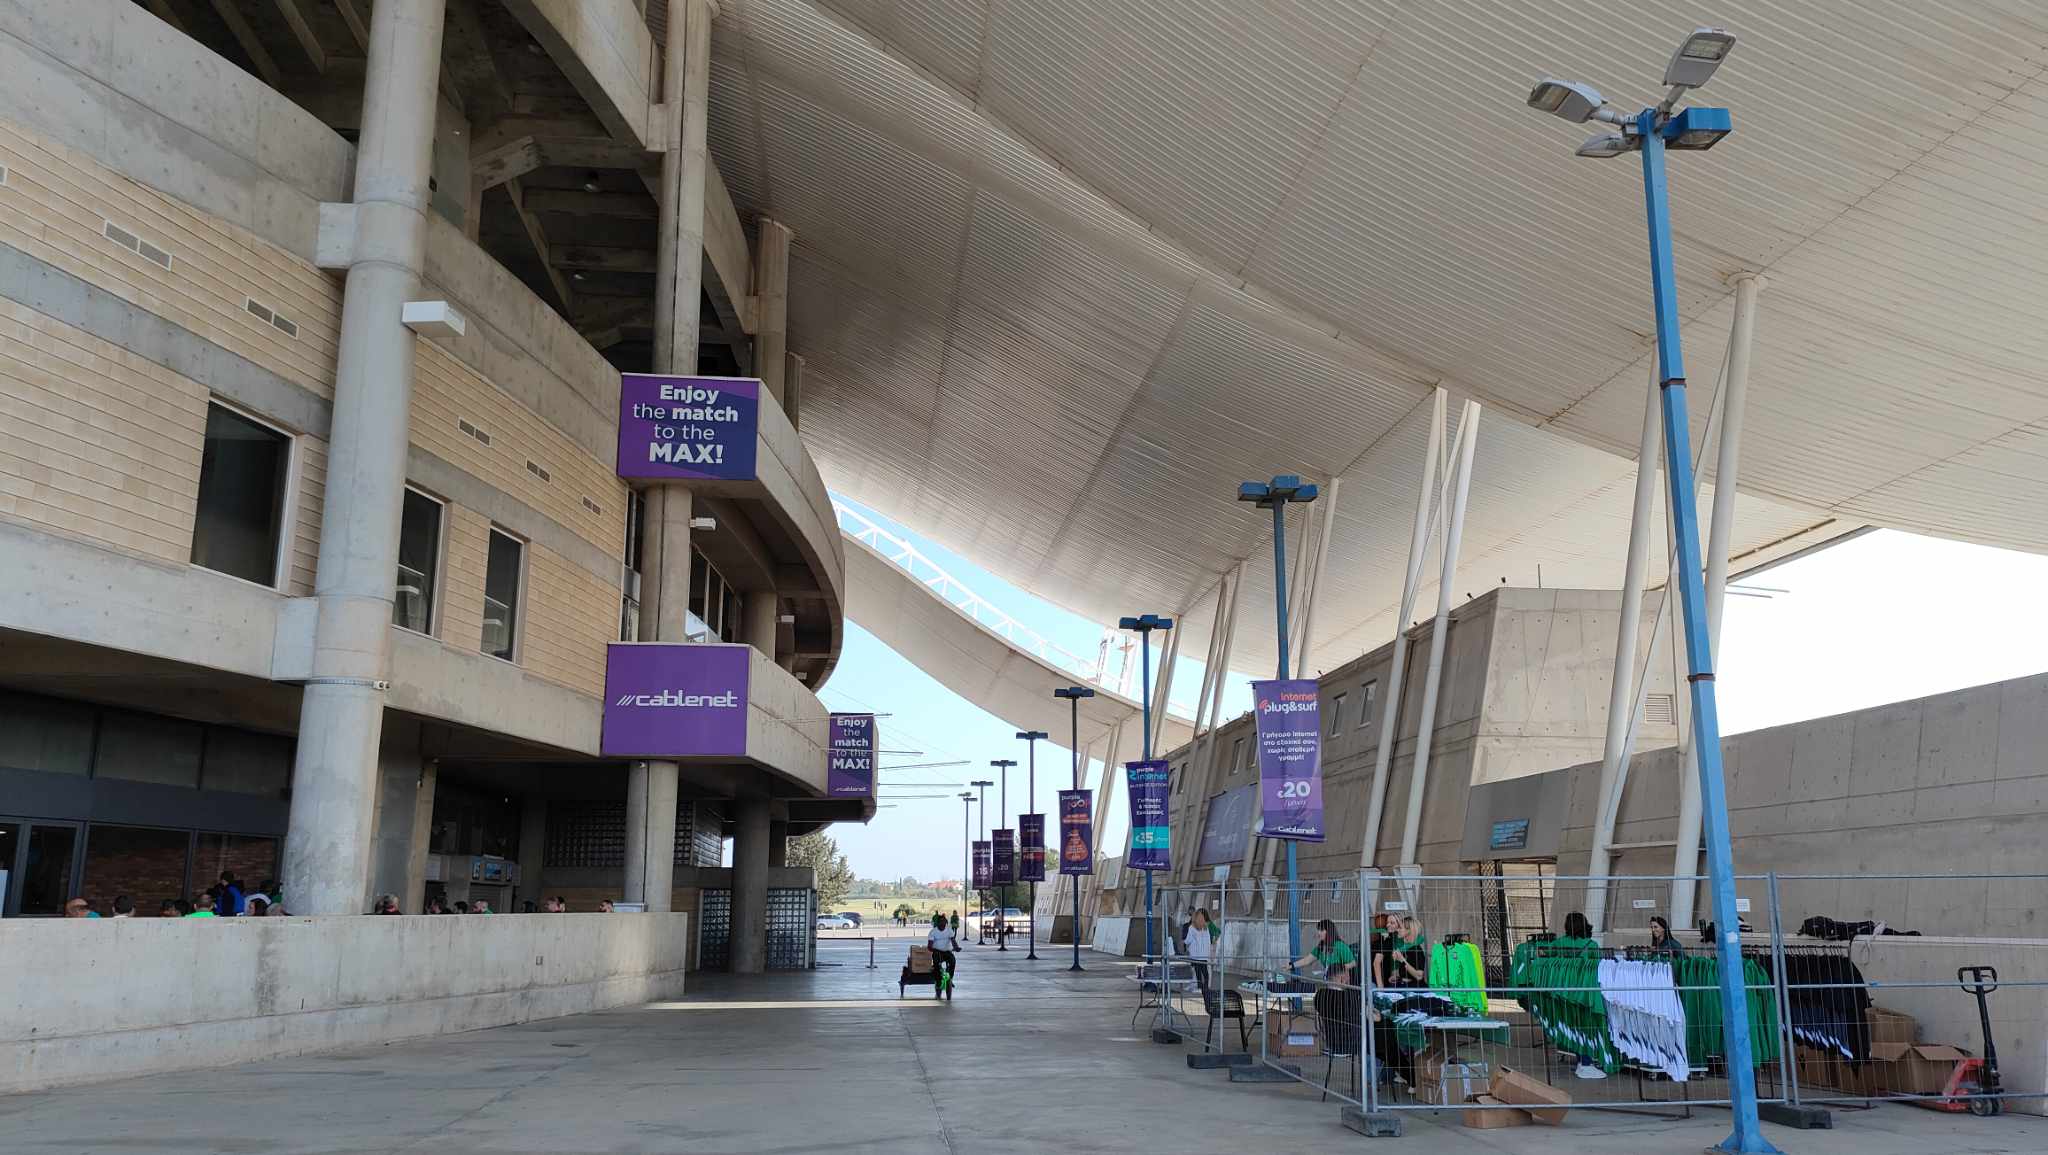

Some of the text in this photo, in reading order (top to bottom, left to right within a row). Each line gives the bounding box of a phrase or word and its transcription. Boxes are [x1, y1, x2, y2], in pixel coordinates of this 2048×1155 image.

[660, 384, 719, 404] Enjoy
[633, 403, 738, 422] the match
[654, 423, 715, 440] to the
[649, 442, 724, 464] MAX!
[1264, 701, 1318, 715] plug&surf
[837, 717, 868, 728] Enjoy
[843, 728, 860, 736] the
[835, 738, 868, 747] match
[832, 758, 870, 769] MAX!
